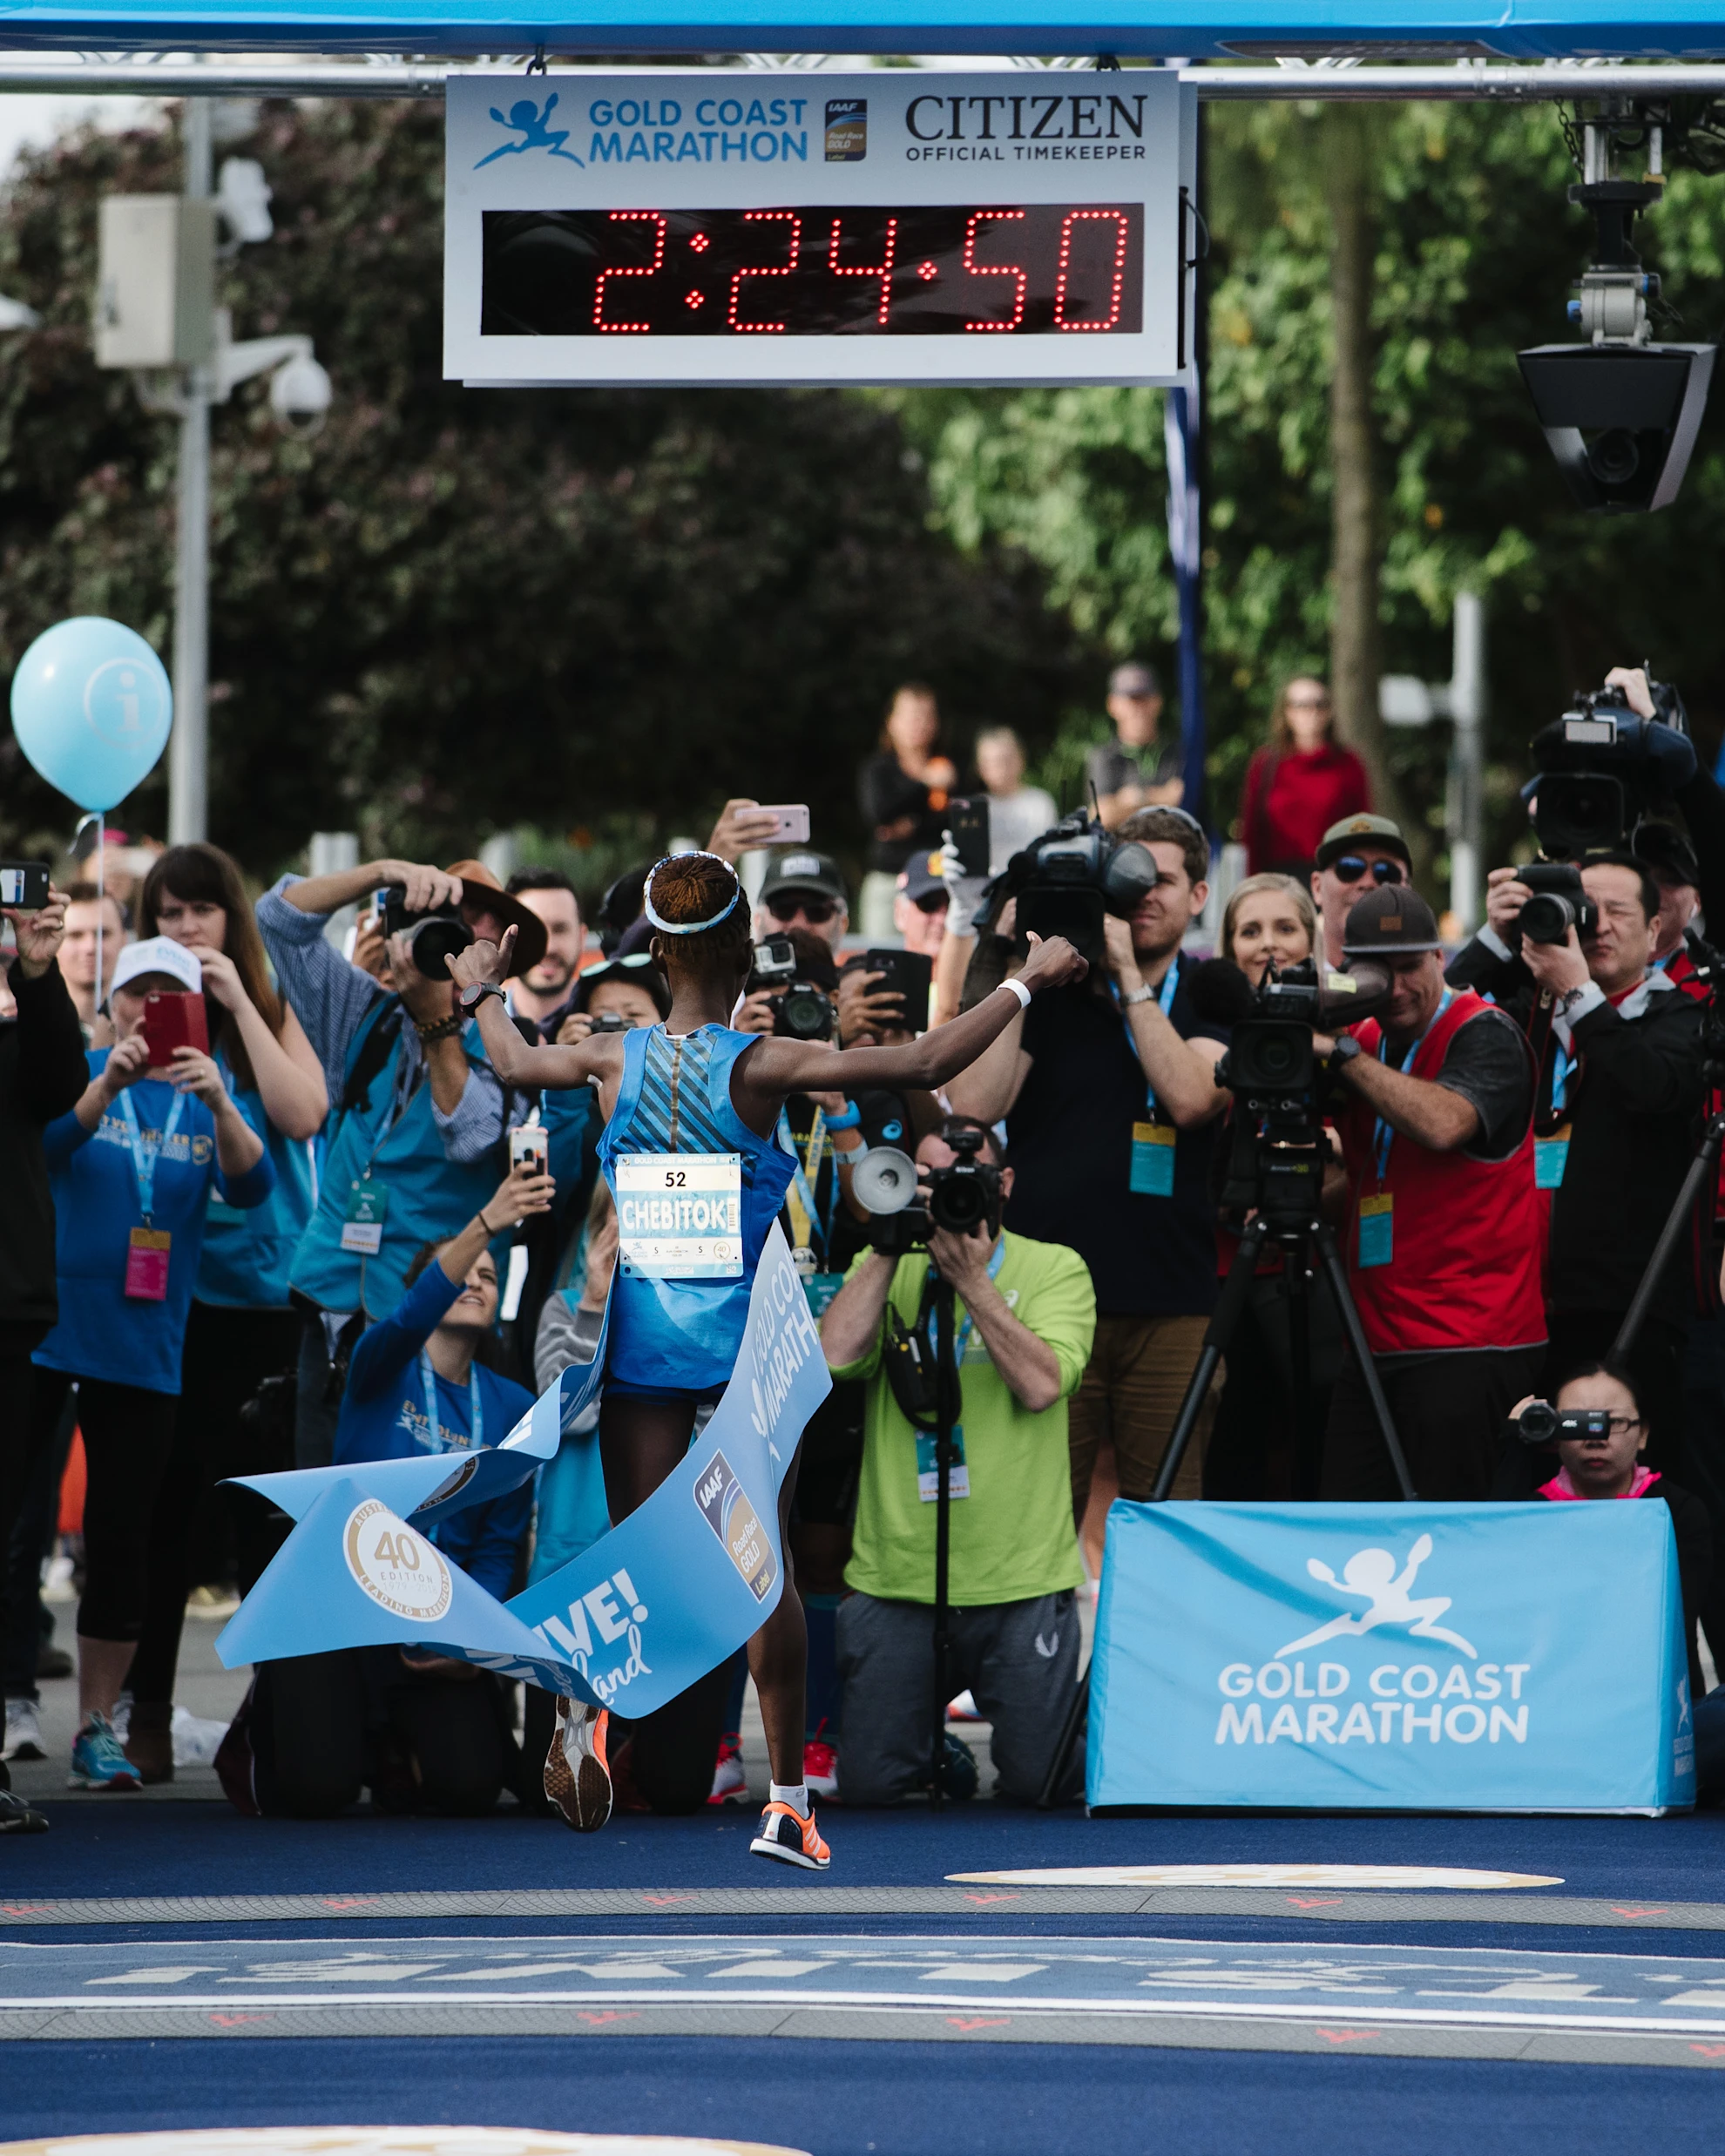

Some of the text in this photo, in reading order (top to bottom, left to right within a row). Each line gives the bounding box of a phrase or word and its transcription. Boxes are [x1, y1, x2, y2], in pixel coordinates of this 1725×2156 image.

[589, 99, 808, 126] GOLD COAST
[829, 102, 857, 112] IAAF
[906, 95, 1147, 140] CITIZEN
[589, 132, 808, 162] MARATHON
[828, 140, 851, 149] GOLD
[906, 145, 1146, 161] OFFICIAL TIMEKEEPER
[666, 1172, 686, 1187] 52
[622, 1200, 727, 1230] CHEBITOK
[700, 1465, 723, 1509] IAAF
[375, 1531, 420, 1571] 40
[732, 1517, 758, 1557] Road Race
[741, 1540, 760, 1573] GOLD
[381, 1571, 433, 1584] EDITION
[754, 1569, 770, 1596] Label
[360, 1573, 450, 1618] LEADING MARATHON
[1218, 1661, 1531, 1700] GOLD COAST
[1214, 1702, 1529, 1745] MARATHON
